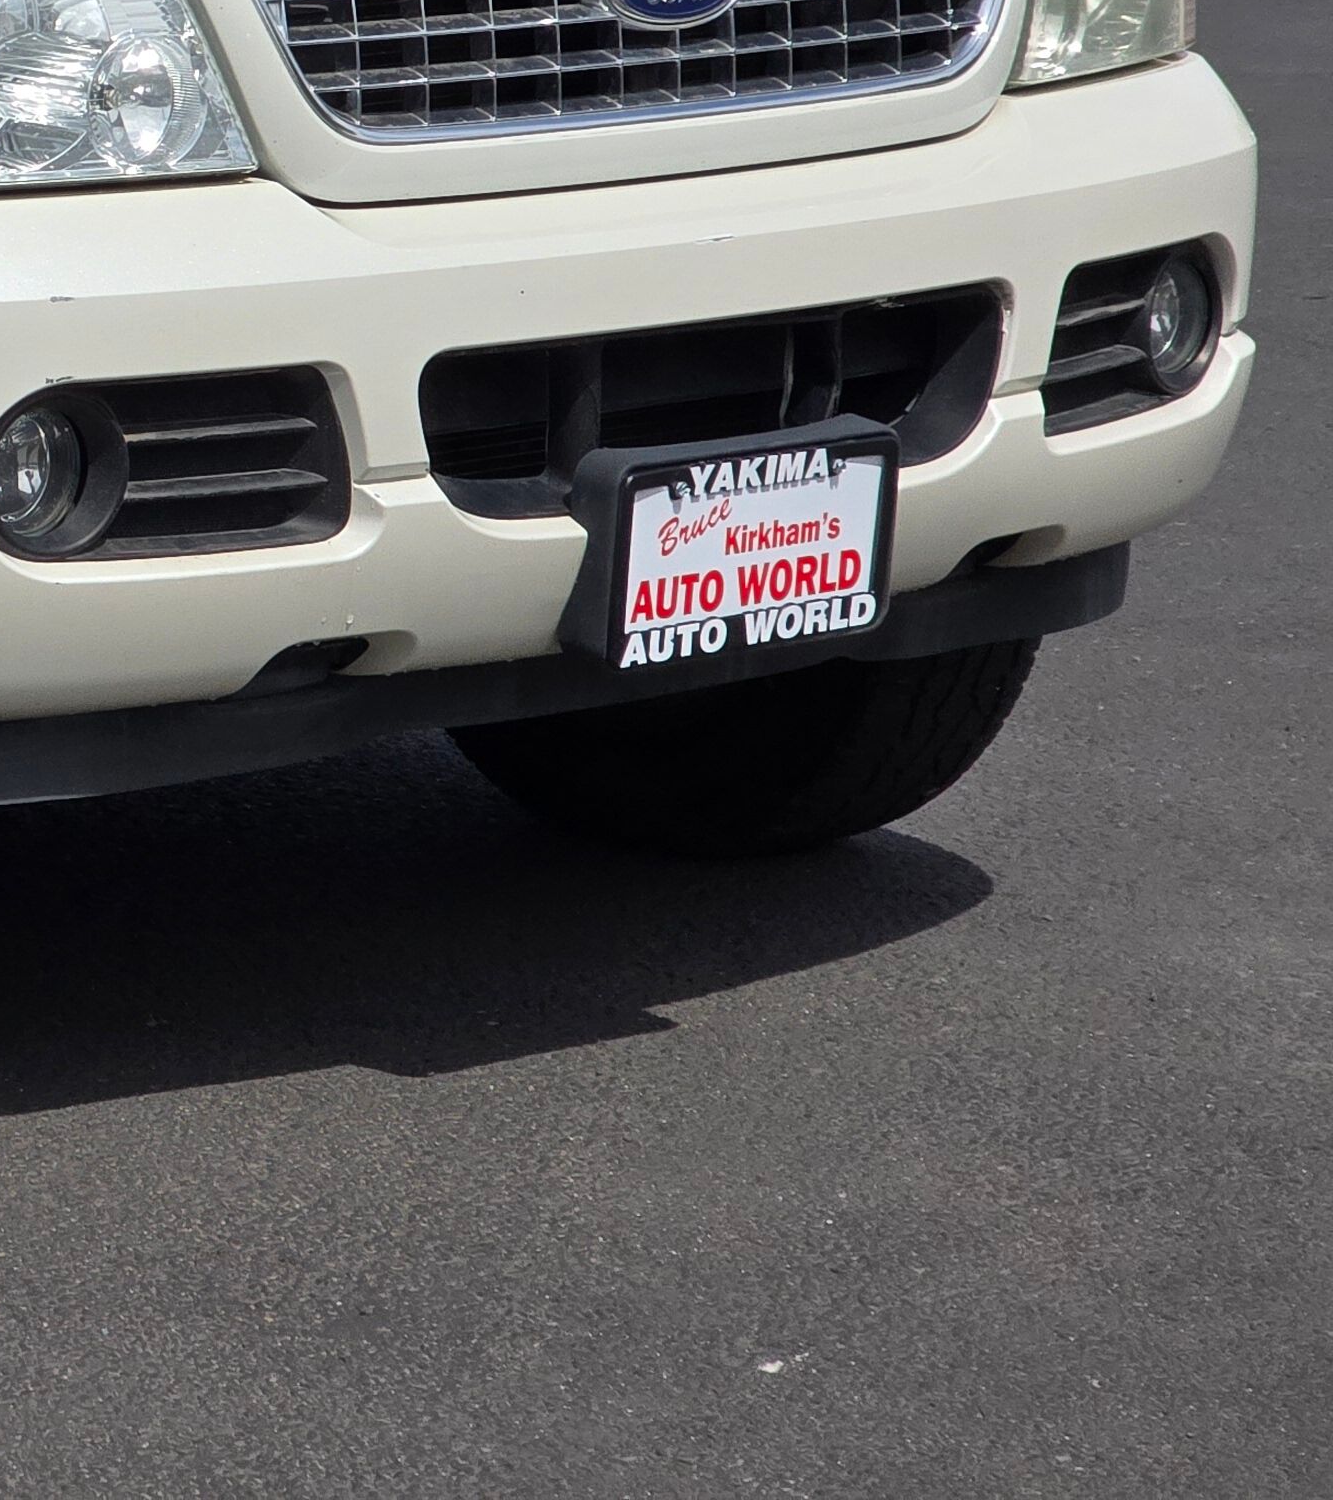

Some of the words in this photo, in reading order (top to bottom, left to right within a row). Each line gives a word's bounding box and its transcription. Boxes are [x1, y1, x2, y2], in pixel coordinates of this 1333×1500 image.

[690, 447, 831, 497] YAKIMA
[658, 497, 732, 556] Bruce
[724, 511, 841, 556] Kirkham's
[630, 570, 725, 624] AUTO
[737, 549, 862, 605] WORLD
[619, 619, 728, 669] AUTO
[744, 592, 876, 646] WORLD
